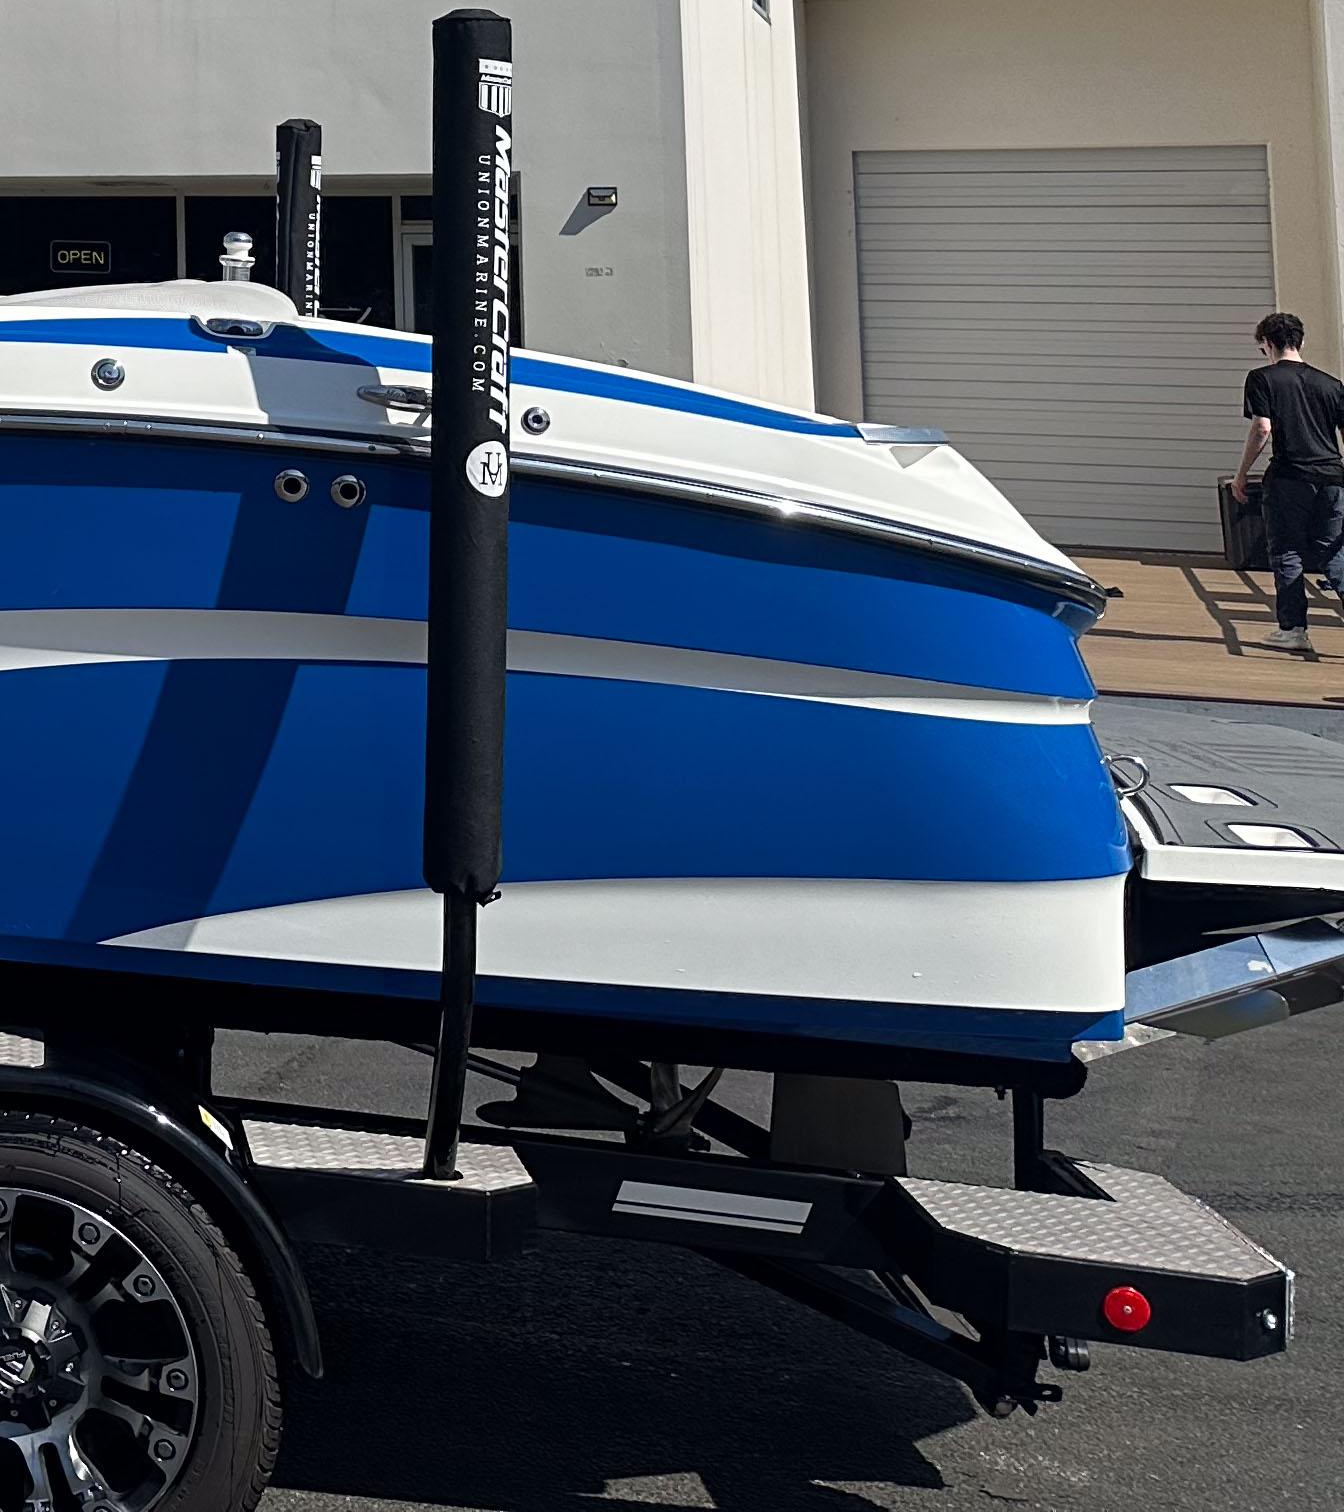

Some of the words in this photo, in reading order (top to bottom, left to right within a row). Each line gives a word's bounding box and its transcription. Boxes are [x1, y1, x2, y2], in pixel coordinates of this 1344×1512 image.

[57, 250, 104, 264] OPEN
[472, 154, 491, 392] UNIONMARINE.COM
[489, 124, 512, 434] MasterCraft
